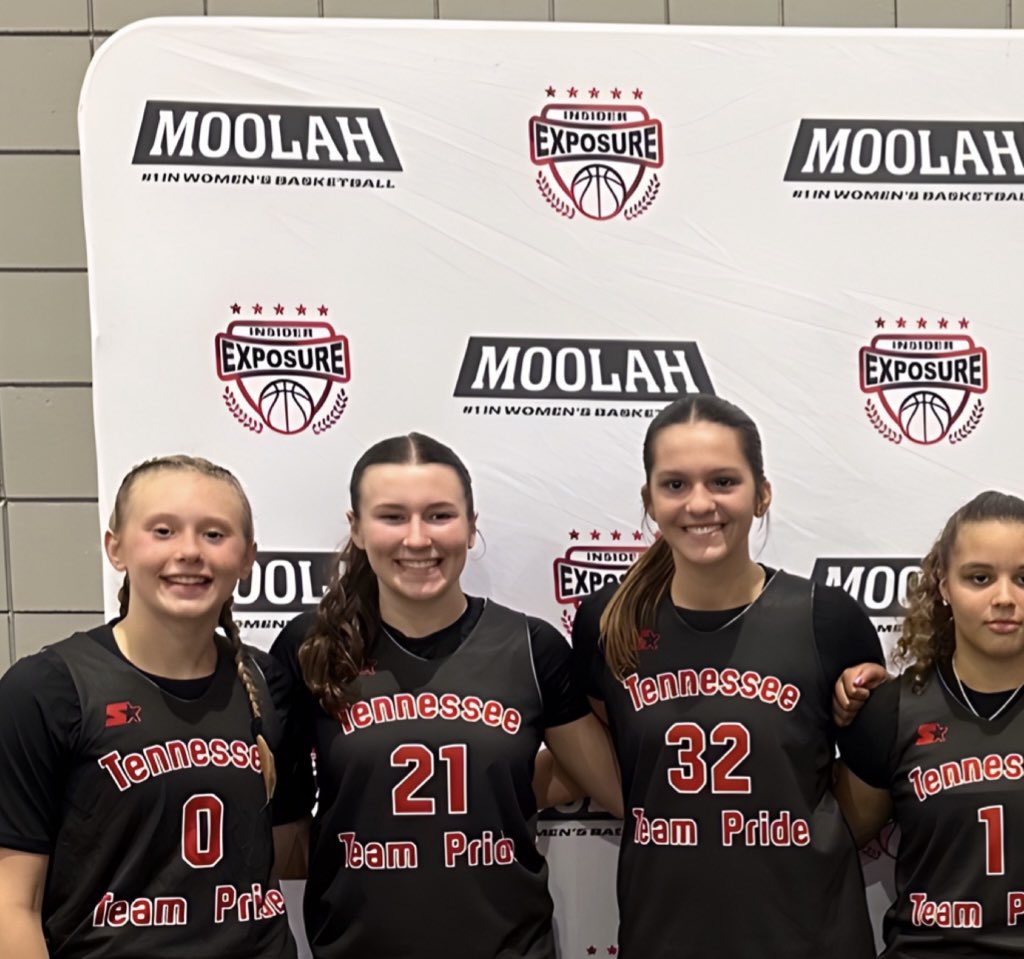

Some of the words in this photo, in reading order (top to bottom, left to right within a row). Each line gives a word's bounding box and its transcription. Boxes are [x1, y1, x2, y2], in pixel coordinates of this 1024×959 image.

[149, 109, 385, 163] MOOLAH
[535, 122, 657, 161] EXPOSURE
[222, 339, 344, 376] EXPOSURE
[471, 346, 700, 393] MOOLAH
[866, 353, 981, 387] EXPOSURE
[232, 559, 331, 605] OOL
[825, 565, 925, 610] MOO
[624, 667, 800, 712] Tennessee
[99, 738, 263, 791] Tennesse
[390, 743, 468, 815] 21
[665, 722, 752, 794] 32
[181, 793, 225, 869] 0
[632, 808, 698, 846] Team
[722, 810, 811, 847] Pride
[977, 804, 1005, 876] 1
[338, 832, 418, 869] Team
[93, 890, 188, 928] Team
[909, 892, 983, 928] Team
